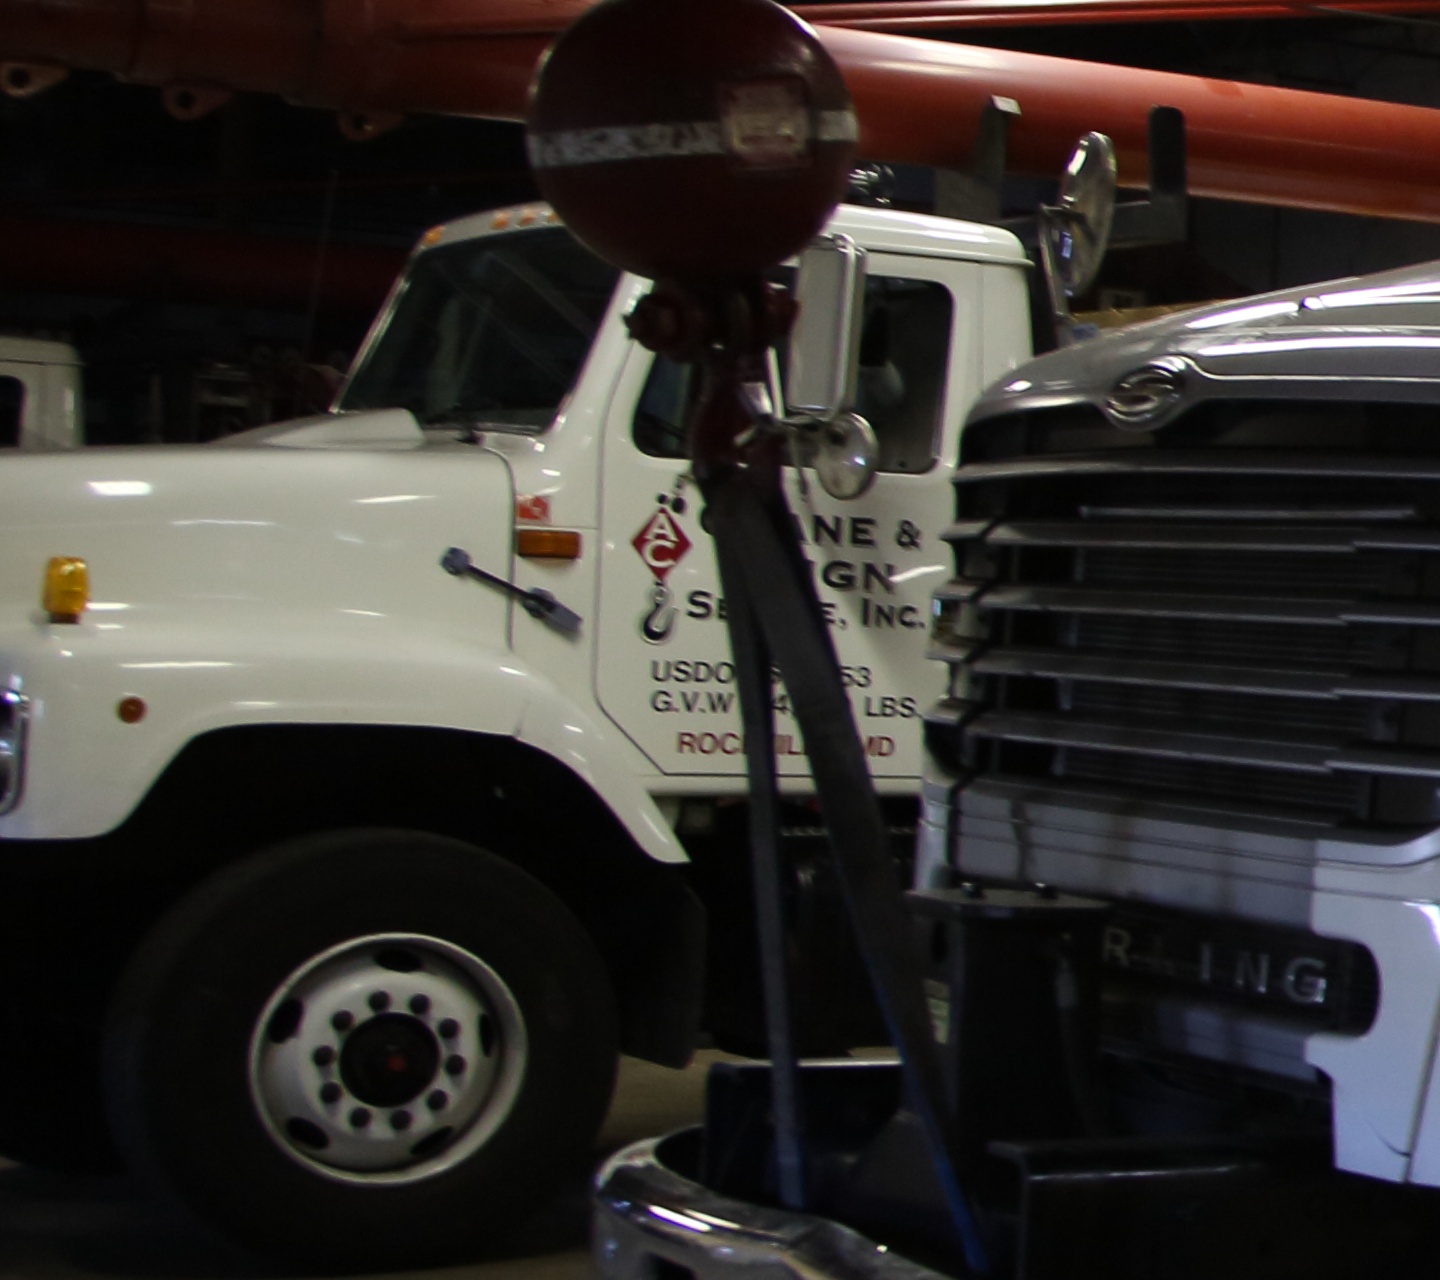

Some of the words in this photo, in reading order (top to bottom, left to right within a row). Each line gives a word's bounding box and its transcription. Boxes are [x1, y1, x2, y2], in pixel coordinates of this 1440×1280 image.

[896, 520, 921, 550] &
[863, 598, 926, 629] INC.
[651, 660, 736, 684] USDO
[651, 690, 736, 714] G.V.W
